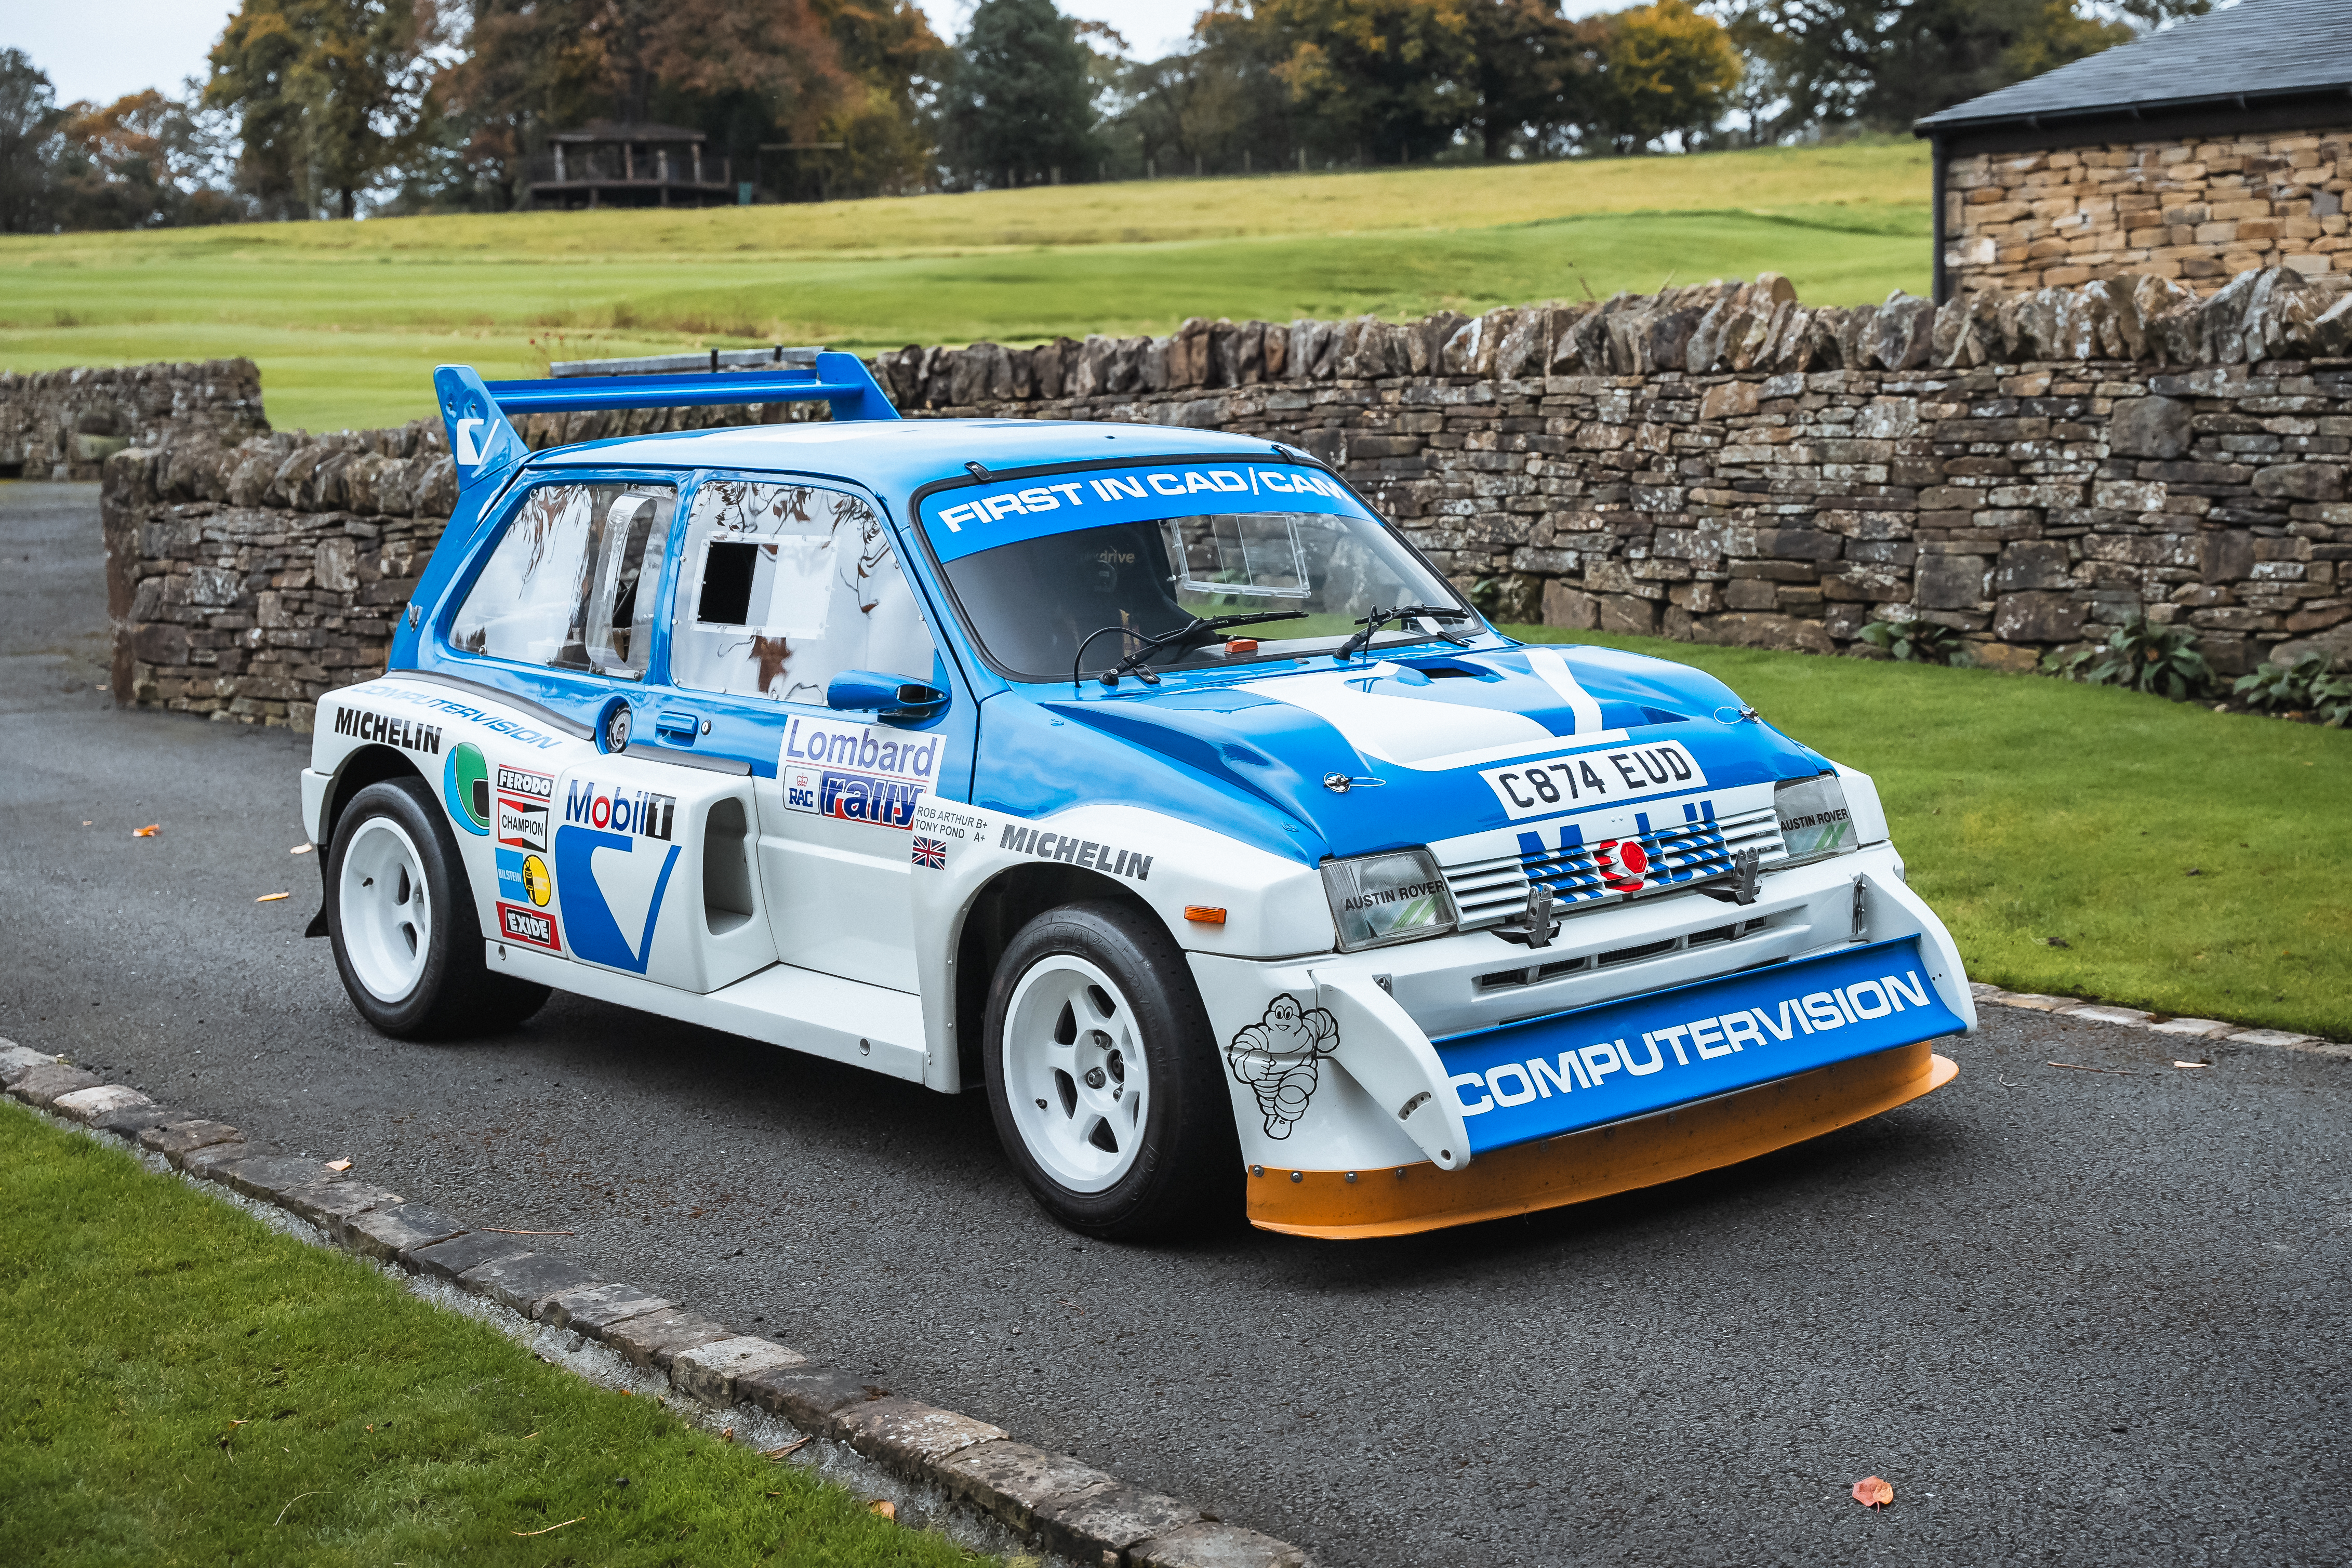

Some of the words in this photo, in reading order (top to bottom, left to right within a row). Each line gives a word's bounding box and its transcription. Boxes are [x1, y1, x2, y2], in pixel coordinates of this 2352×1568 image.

[937, 482, 1083, 533] FIRST
[1089, 475, 1149, 502] IN
[1146, 467, 1353, 502] CAD/CAM
[334, 707, 443, 755] MICHELIN
[351, 685, 563, 749] COMPUTERVISION
[786, 719, 937, 777] Lombard
[499, 770, 551, 796] FERODO
[1498, 760, 1606, 808] C874
[1607, 747, 1692, 789] EUD
[565, 779, 649, 835] Mobil
[789, 787, 814, 808] RAC
[824, 777, 927, 828] rally
[502, 814, 543, 837] CHAMPION
[915, 819, 938, 833] TONY
[939, 825, 965, 839] POND
[973, 832, 986, 843] A+
[917, 806, 936, 819] ROB
[937, 810, 974, 828] ARTHUR
[976, 818, 988, 830] B+
[1780, 815, 1816, 832] AUSTIN
[1816, 808, 1850, 825] ROVER
[999, 823, 1154, 881] MICHELIN
[498, 868, 522, 883] BILSTEIN
[1345, 889, 1396, 911] AUSTIN
[1398, 880, 1445, 900] ROVER
[508, 912, 549, 939] EXIDE
[1449, 969, 1932, 1117] COMPUTERVISION
